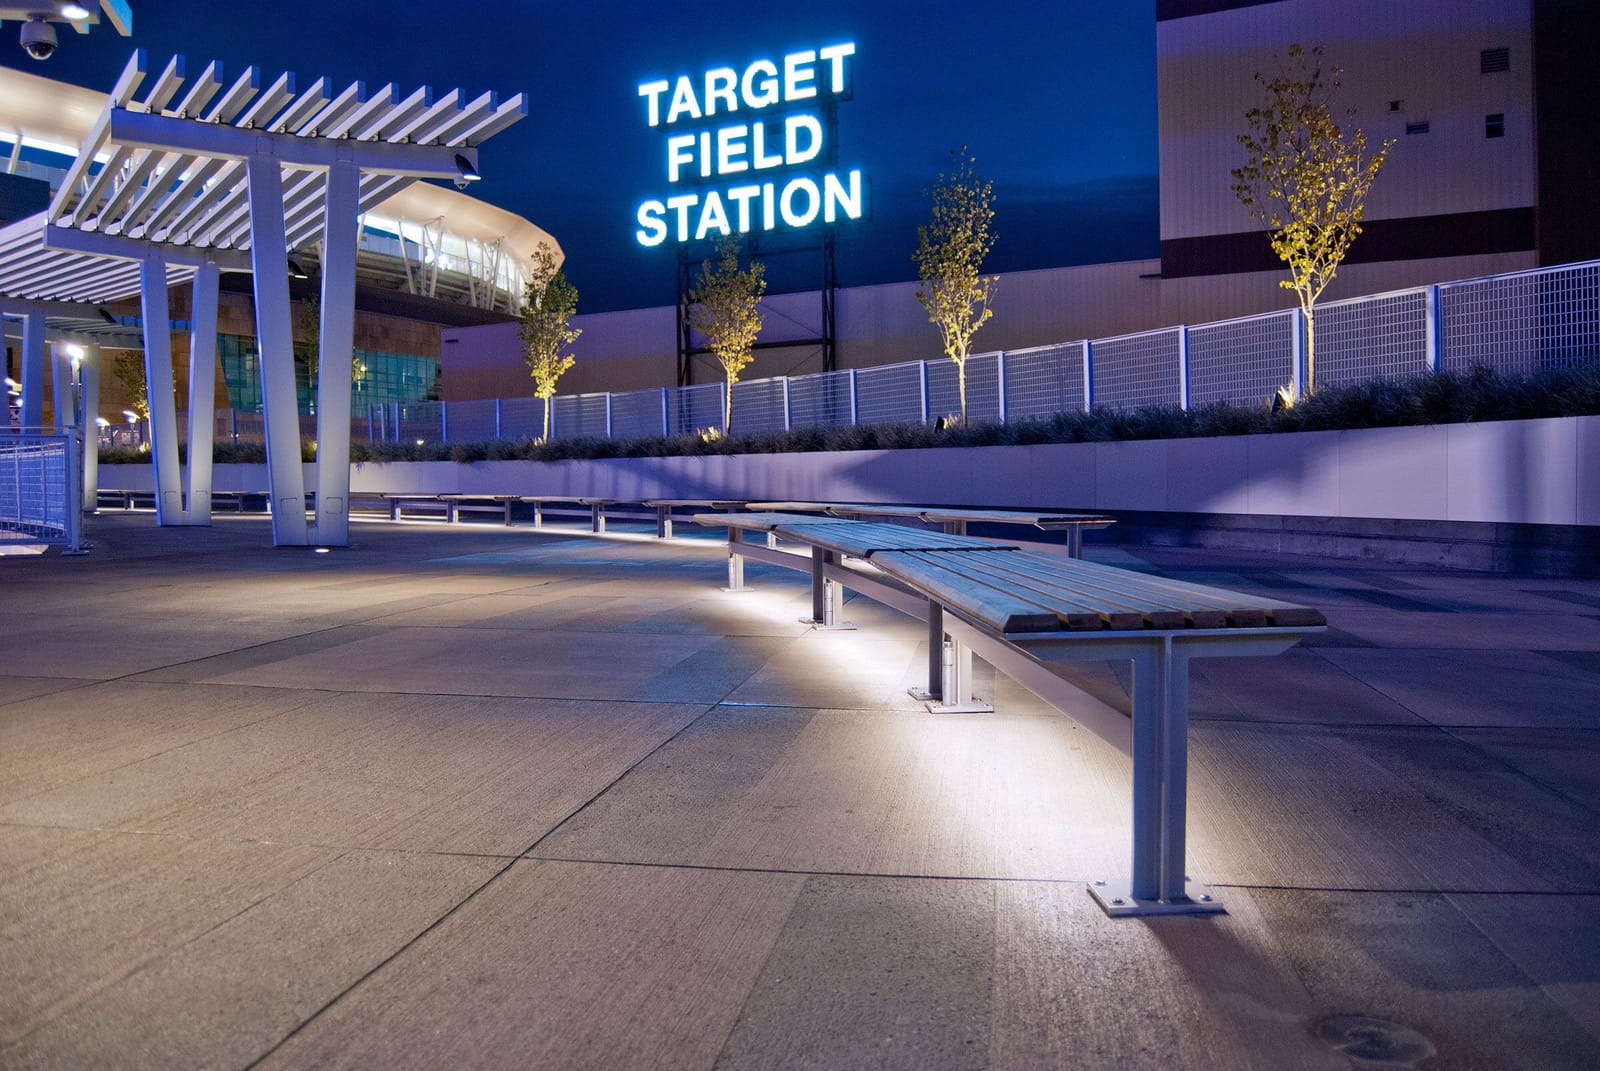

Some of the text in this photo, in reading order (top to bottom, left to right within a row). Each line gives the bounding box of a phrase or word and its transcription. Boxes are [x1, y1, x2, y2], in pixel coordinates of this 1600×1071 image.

[638, 43, 855, 127] TARGET
[667, 115, 823, 182] FIELD
[636, 170, 861, 247] STATION
